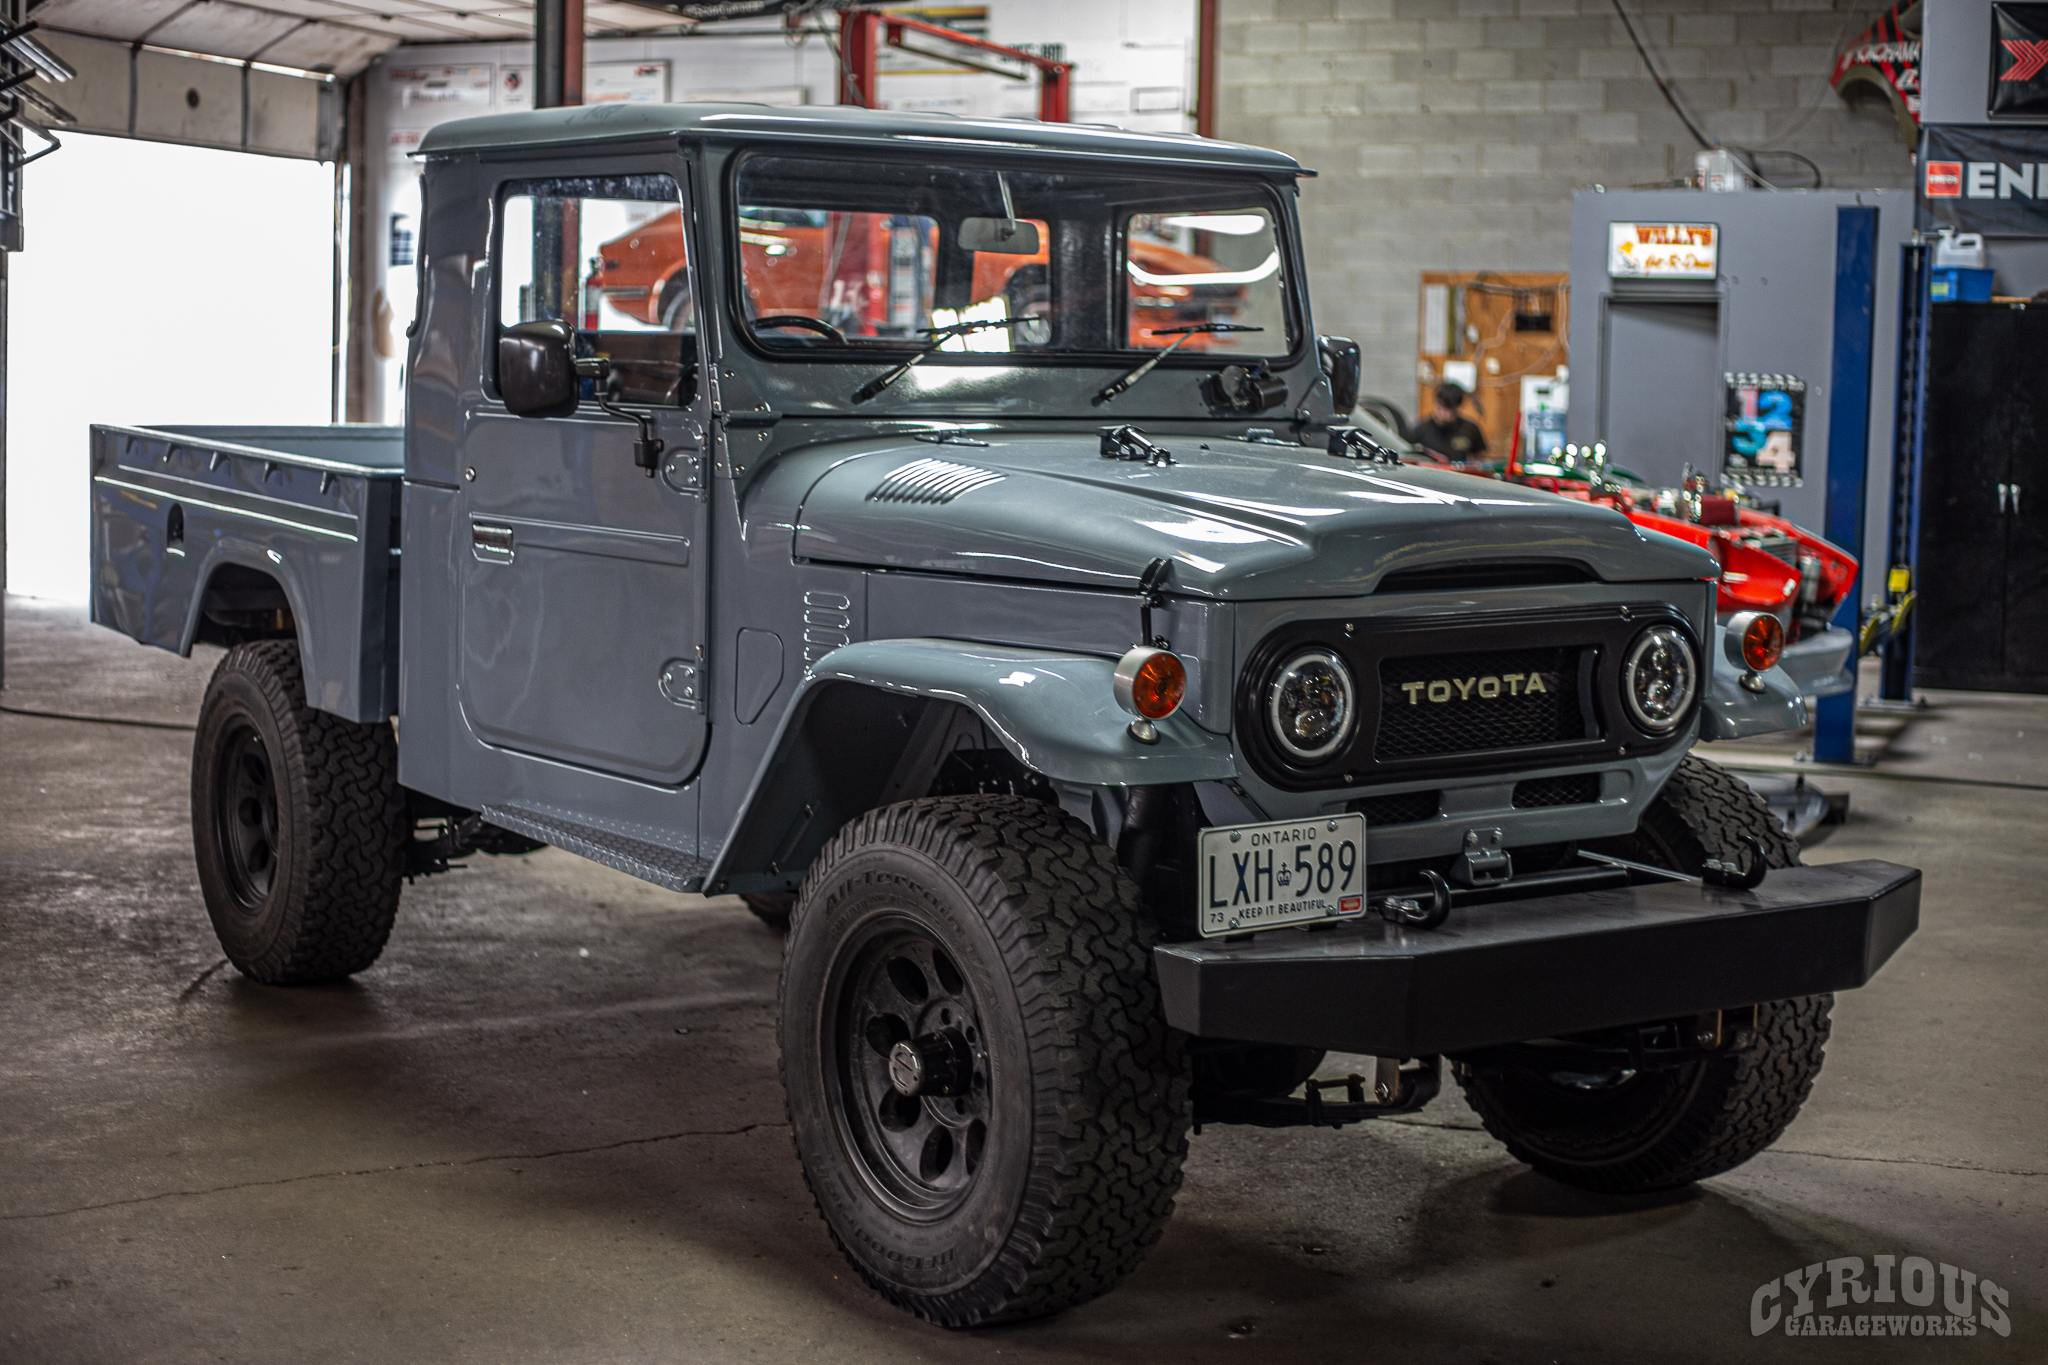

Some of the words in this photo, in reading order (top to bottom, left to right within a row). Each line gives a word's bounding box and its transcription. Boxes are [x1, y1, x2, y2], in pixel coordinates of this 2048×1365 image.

[1401, 672, 1547, 705] TOYOTA
[1251, 827, 1317, 847] ONTARIO
[1209, 848, 1274, 909] LXH
[1295, 840, 1357, 897] 589
[1210, 912, 1225, 924] 73
[1238, 906, 1263, 920] KEEP
[1265, 904, 1275, 917] IT
[1278, 898, 1327, 914] BEAUTIFUL
